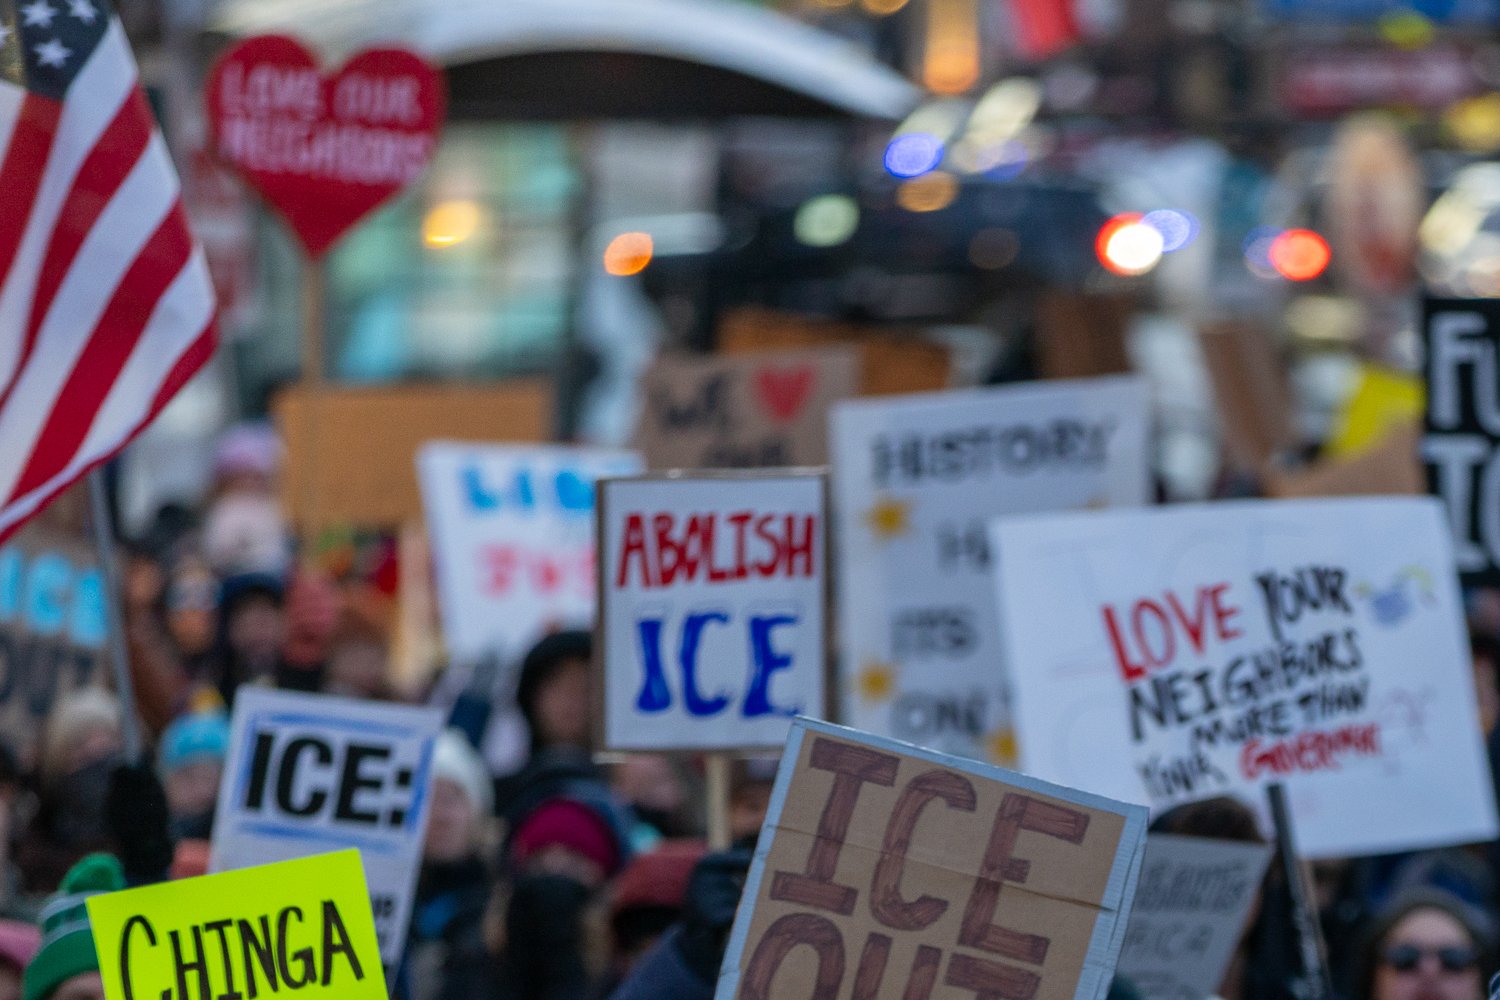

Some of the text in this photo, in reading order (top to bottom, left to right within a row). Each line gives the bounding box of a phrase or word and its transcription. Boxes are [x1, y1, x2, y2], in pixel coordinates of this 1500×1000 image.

[870, 412, 1120, 489] HISTORY
[617, 511, 817, 590] ABOLISH
[635, 611, 811, 718] ICE
[1100, 565, 1354, 684] LOVE YOUR
[1126, 623, 1364, 744] NEIGHBORS
[246, 730, 413, 829] ICE:
[770, 736, 1091, 967] ICE
